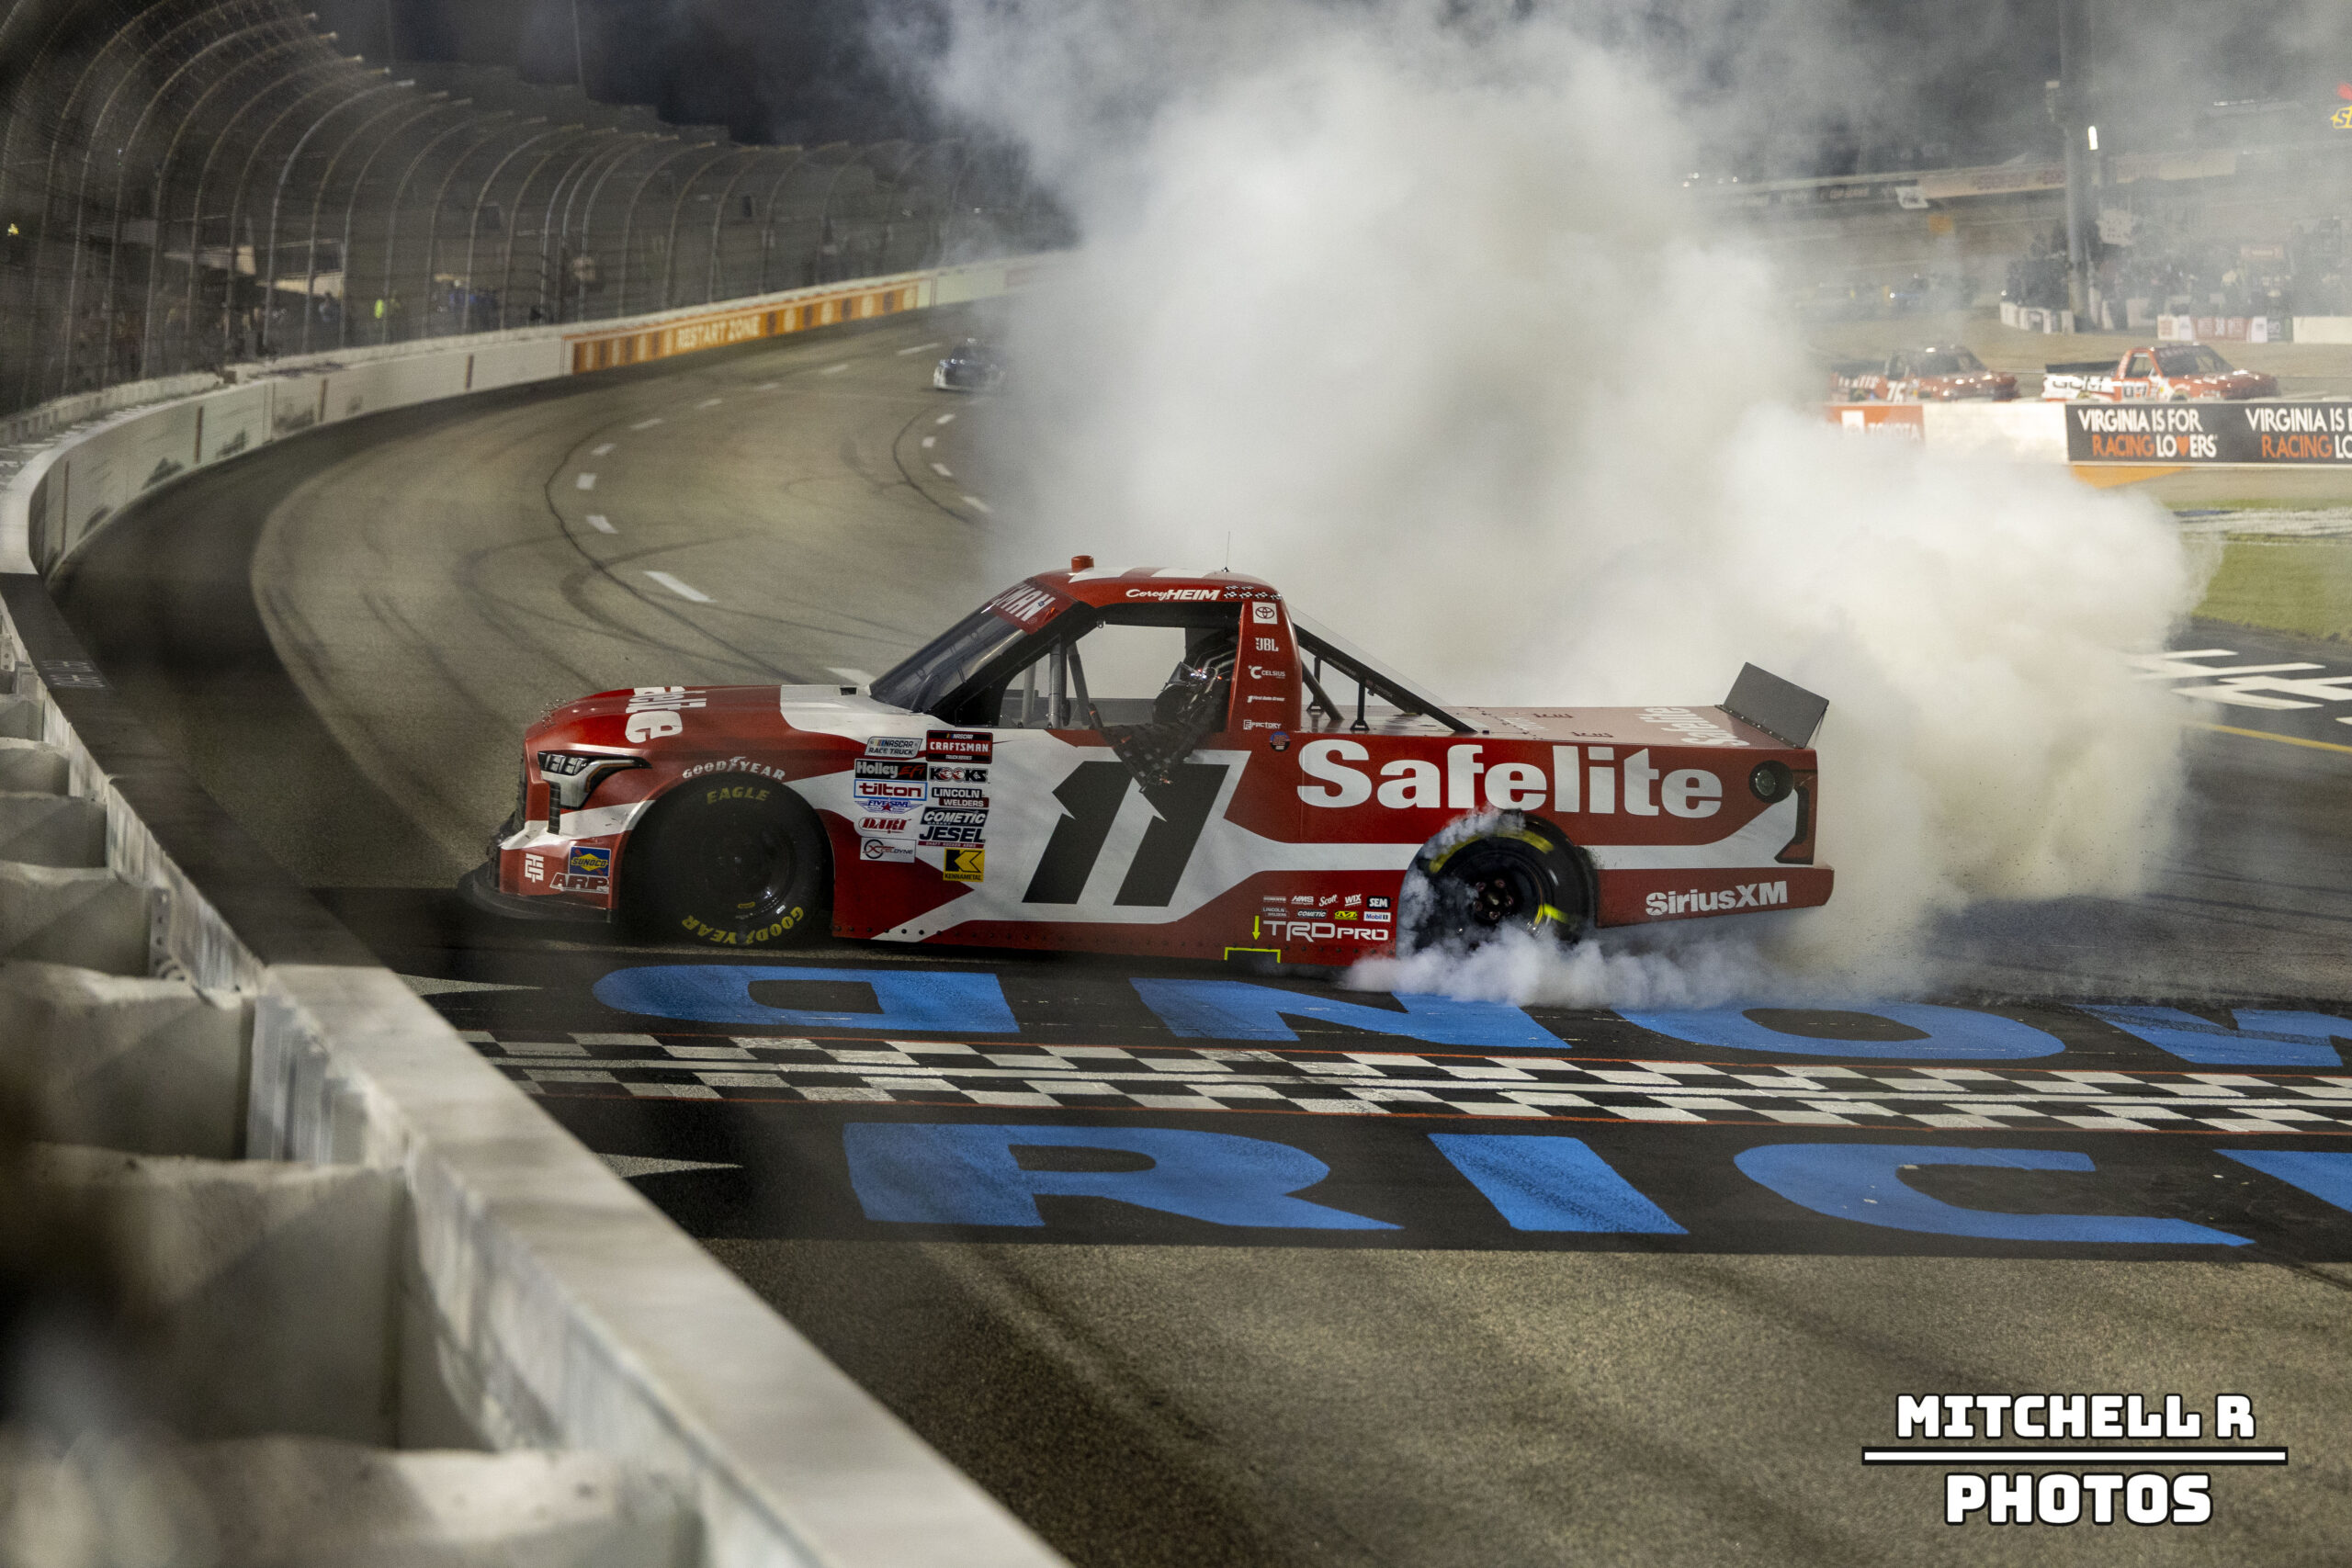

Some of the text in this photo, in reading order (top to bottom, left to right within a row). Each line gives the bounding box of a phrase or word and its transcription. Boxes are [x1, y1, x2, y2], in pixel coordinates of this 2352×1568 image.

[676, 314, 761, 351] RESTART ZONE
[2077, 408, 2203, 433] VIRGINIA IS FOR
[2245, 407, 2327, 433] VIRGINIA
[2329, 408, 2343, 433] IS
[2092, 434, 2154, 457] RACING
[2261, 434, 2333, 458] RACING
[1256, 637, 1279, 651] JBL
[885, 739, 913, 749] NASCAR
[889, 748, 914, 756] TRUCK
[930, 741, 989, 752] CRAFTSMAN
[682, 756, 786, 781] GOODYEAR
[856, 761, 899, 779] Holley
[930, 766, 988, 783] KOOKS
[1296, 739, 1723, 818] Safelite
[706, 786, 771, 805] EAGLE
[859, 783, 922, 797] tilton
[933, 788, 980, 798] LINCOLN
[944, 798, 984, 807] WELDERS
[862, 818, 908, 831] DART
[923, 811, 987, 825] COMETIC
[919, 826, 986, 843] JESEL
[1022, 761, 1230, 908] 11
[571, 858, 606, 867] SUNOCO
[550, 872, 609, 891] ARP
[944, 873, 982, 881] KENNAMETAL
[1344, 894, 1363, 905] WIX
[1369, 897, 1388, 908] SEM
[1645, 880, 1788, 917] SiriusXM
[681, 905, 805, 946] GOODYEAR
[1263, 920, 1389, 942] TRD PRO
